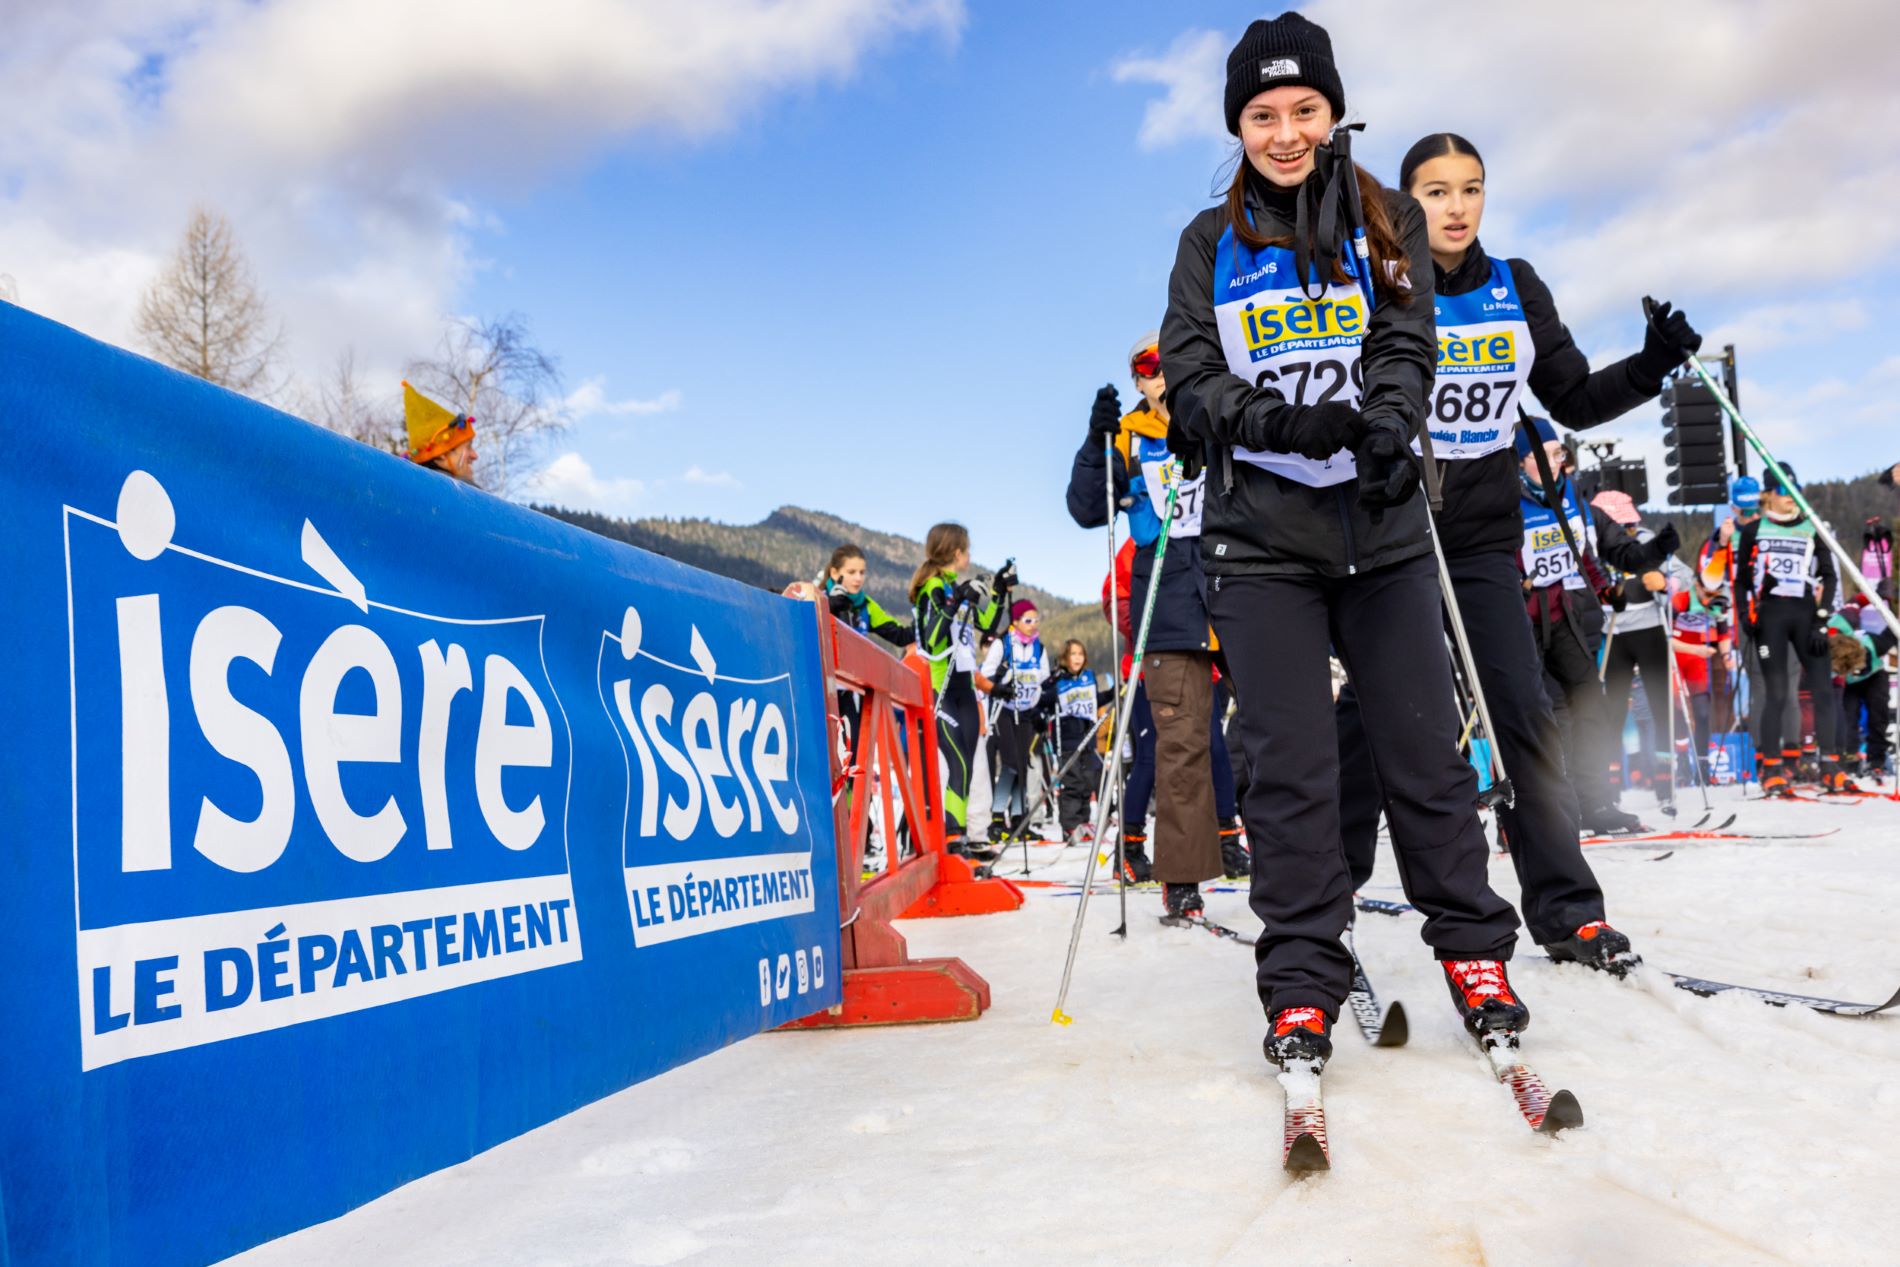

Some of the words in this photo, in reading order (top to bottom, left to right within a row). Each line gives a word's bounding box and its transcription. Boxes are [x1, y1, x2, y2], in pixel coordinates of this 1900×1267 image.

[1229, 261, 1278, 289] AUTRANS
[1245, 296, 1360, 345] isère
[1256, 349, 1269, 359] LE
[1270, 335, 1362, 354] DÉPARTEMENT
[1460, 428, 1499, 443] Blanche
[116, 470, 553, 873] isère
[614, 606, 799, 841] isère
[633, 887, 662, 929] LE
[668, 869, 810, 923] DÉPARTEMENT
[92, 954, 183, 1036] LE
[203, 898, 571, 1014] DÉPARTEMENT
